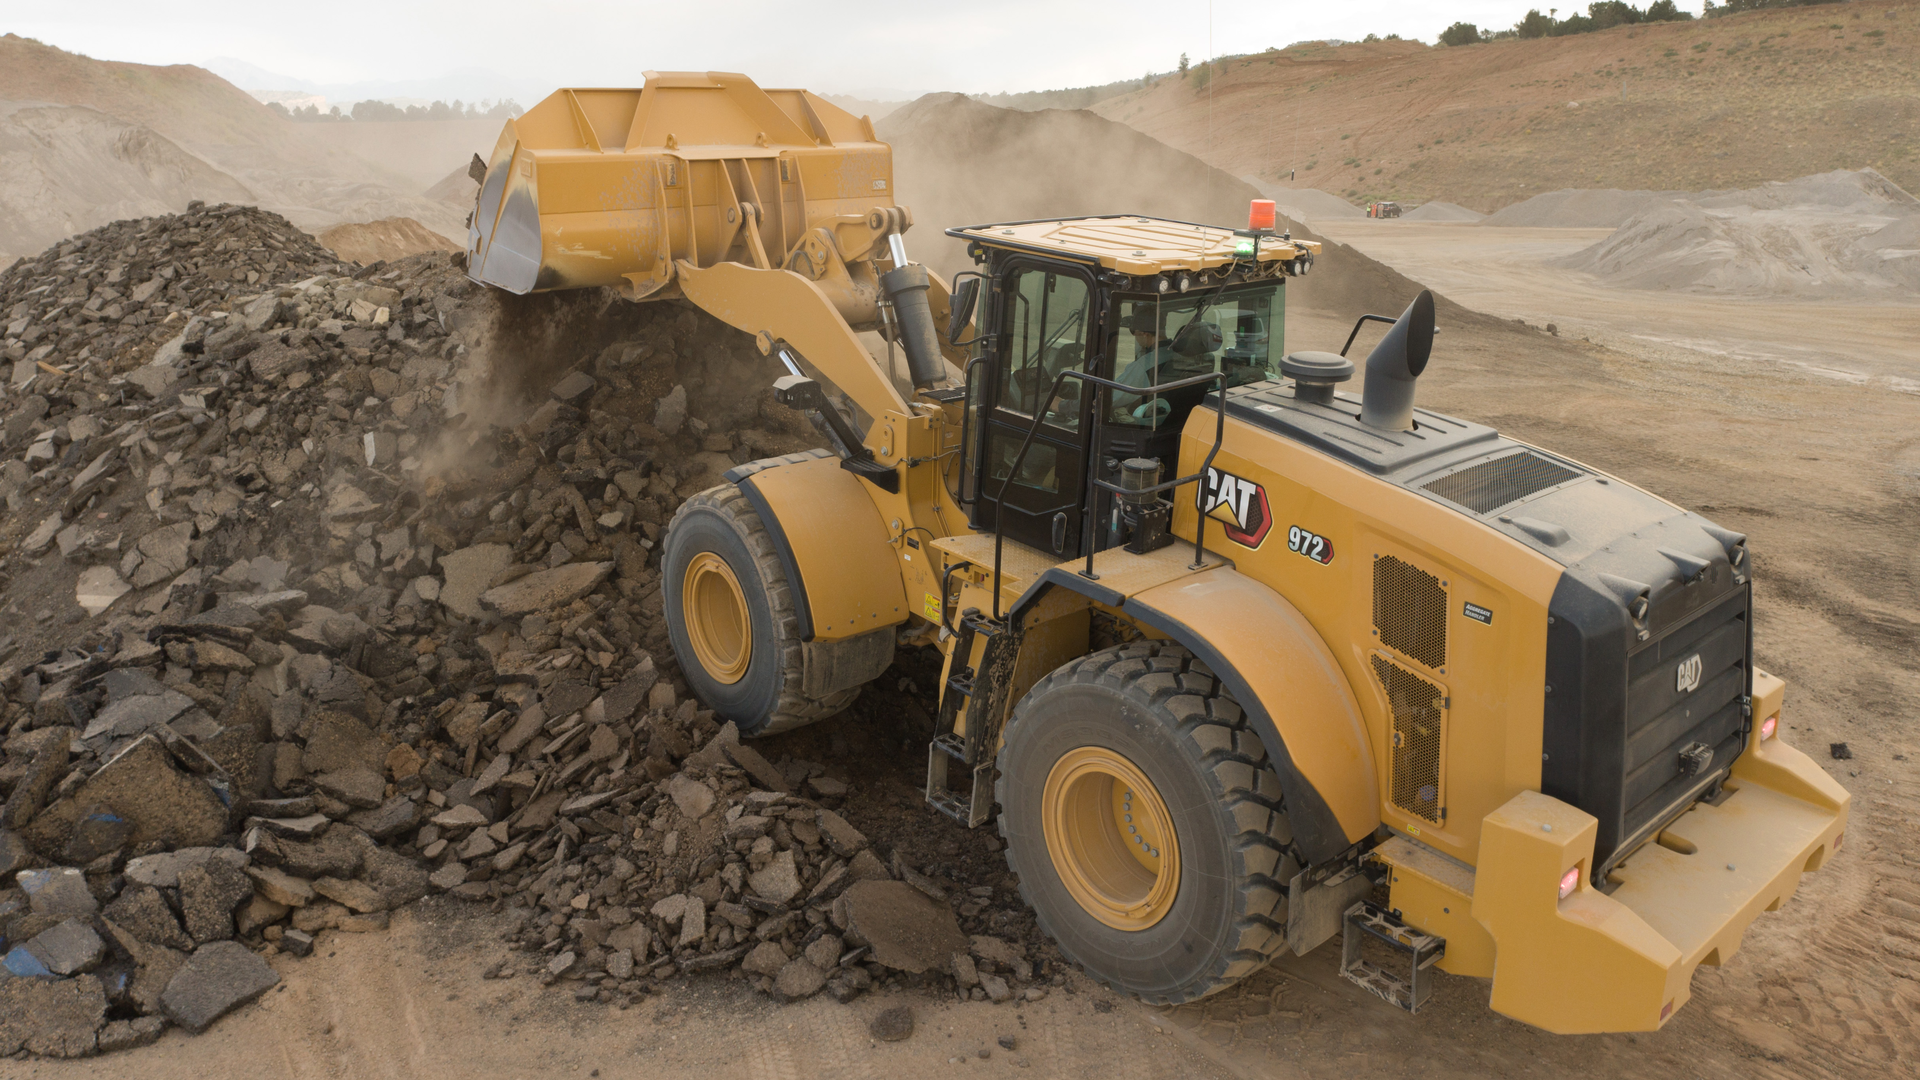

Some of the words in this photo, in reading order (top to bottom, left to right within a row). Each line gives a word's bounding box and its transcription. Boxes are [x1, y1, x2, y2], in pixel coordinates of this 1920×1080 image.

[1198, 467, 1256, 530] CAT
[1288, 526, 1324, 561] 972
[1677, 653, 1700, 692] CAT
